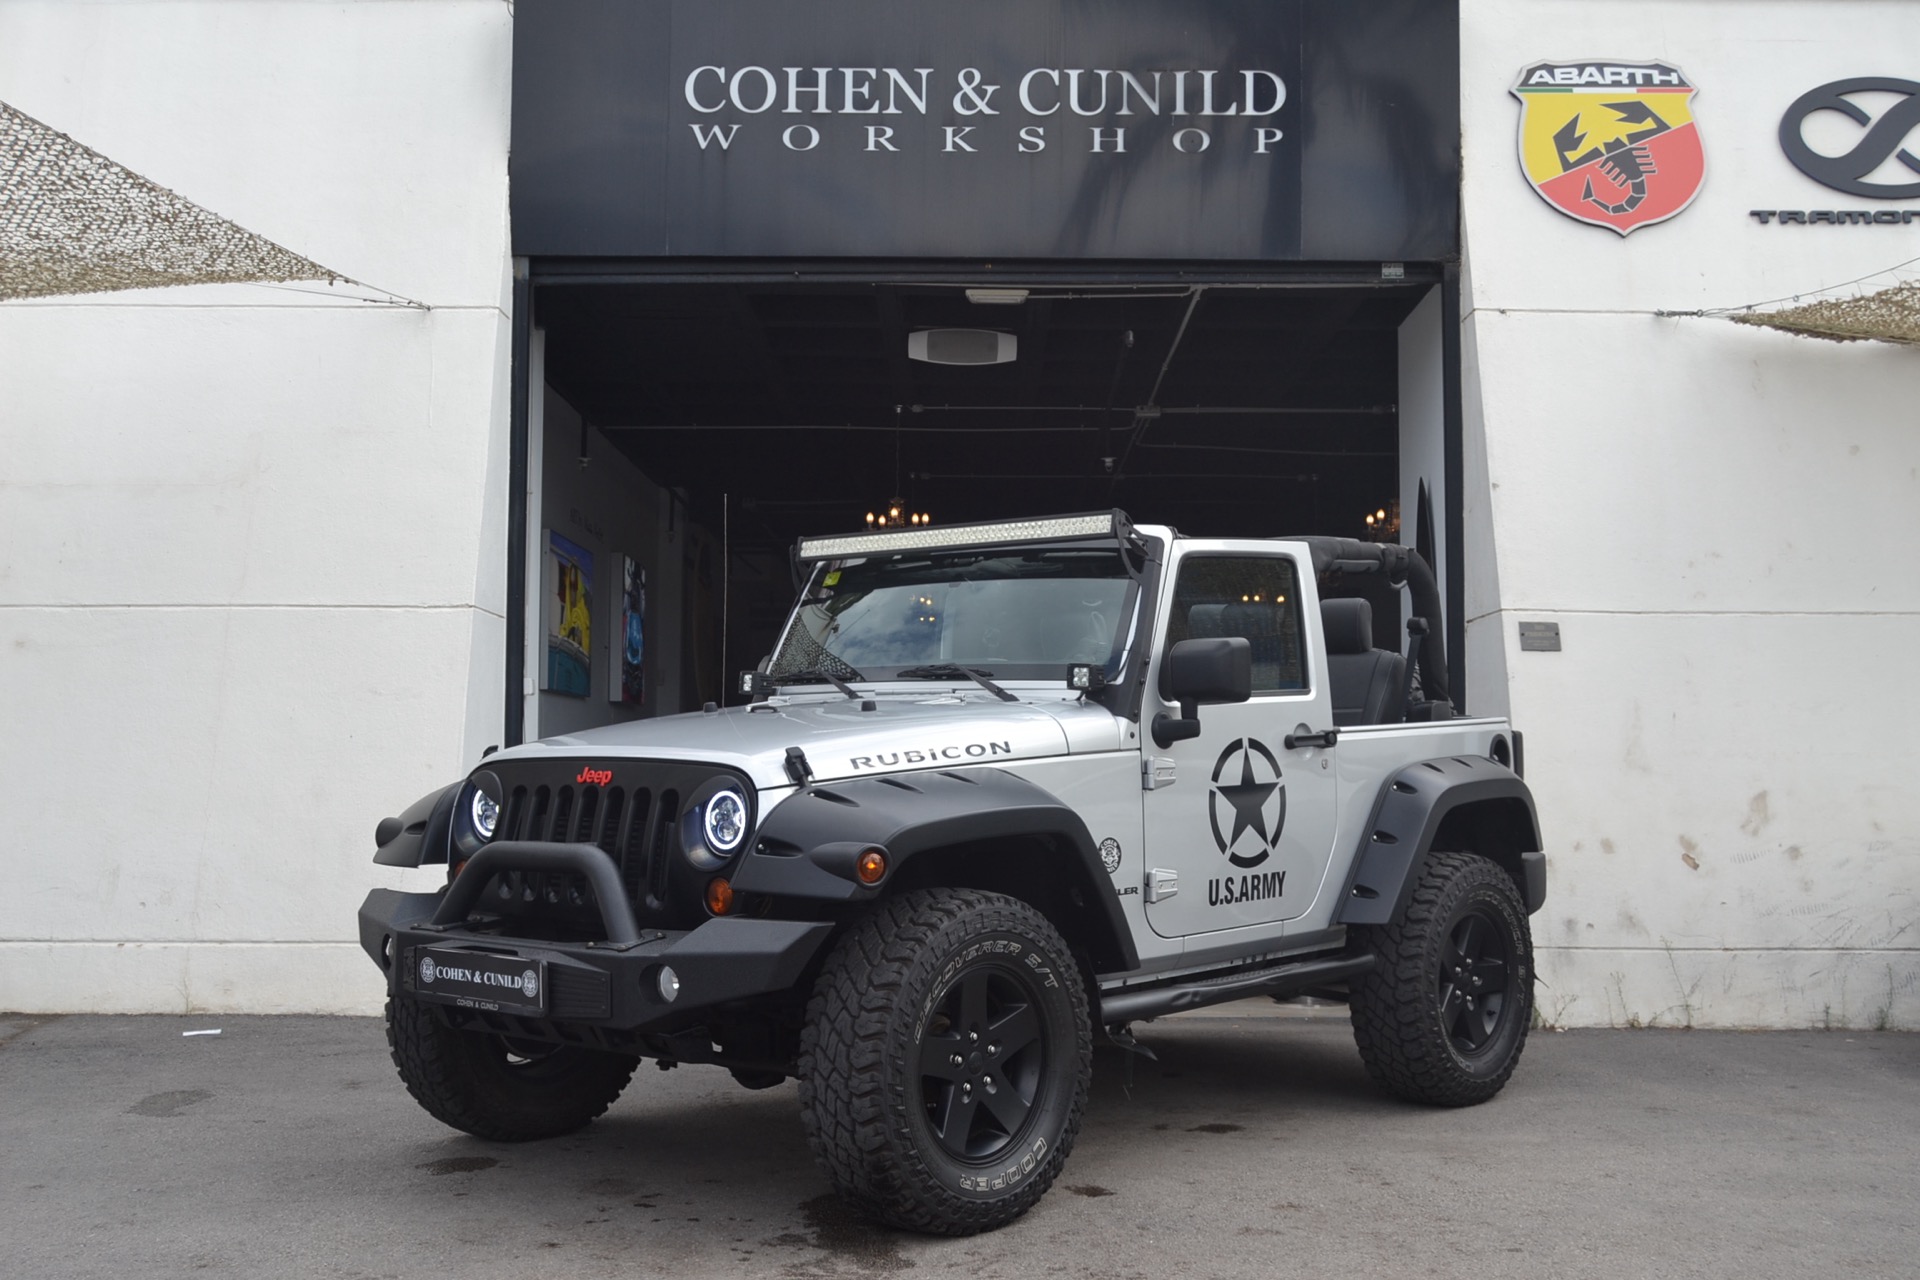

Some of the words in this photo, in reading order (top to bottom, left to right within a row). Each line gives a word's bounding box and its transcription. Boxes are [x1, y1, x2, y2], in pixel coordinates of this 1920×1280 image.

[685, 65, 934, 114] COHEN
[952, 67, 1000, 115] &
[1018, 68, 1287, 116] CUNILD
[1527, 66, 1680, 85] ABARTH
[688, 123, 1284, 153] WORKSHOP
[576, 766, 612, 787] Jeep
[1208, 871, 1287, 906] U.S.ARMY
[435, 966, 472, 982] COHEN
[473, 970, 482, 984] &
[483, 971, 522, 989] CUNILD
[913, 940, 1022, 1045] DISCOVERER
[1024, 952, 1060, 989] S/T
[960, 1137, 1047, 1192] COOPER
